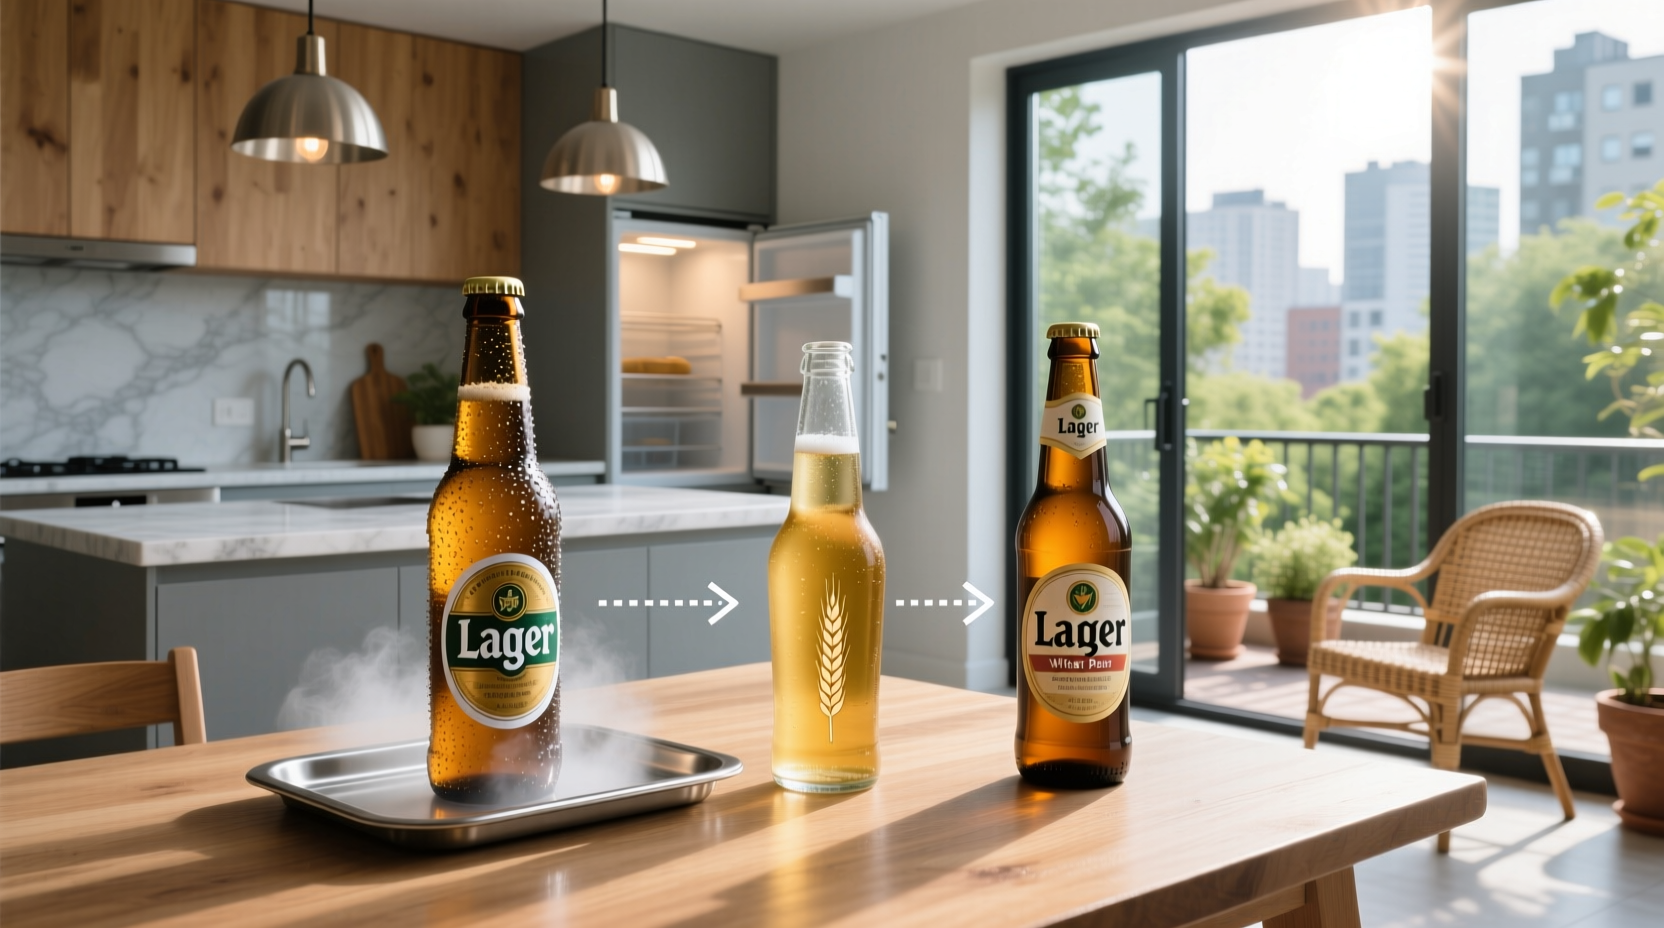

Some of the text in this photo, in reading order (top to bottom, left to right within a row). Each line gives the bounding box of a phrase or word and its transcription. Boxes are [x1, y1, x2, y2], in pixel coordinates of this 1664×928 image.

[1057, 417, 1099, 439] Lager
[457, 618, 555, 671] Lager
[1034, 610, 1126, 657] Lager
